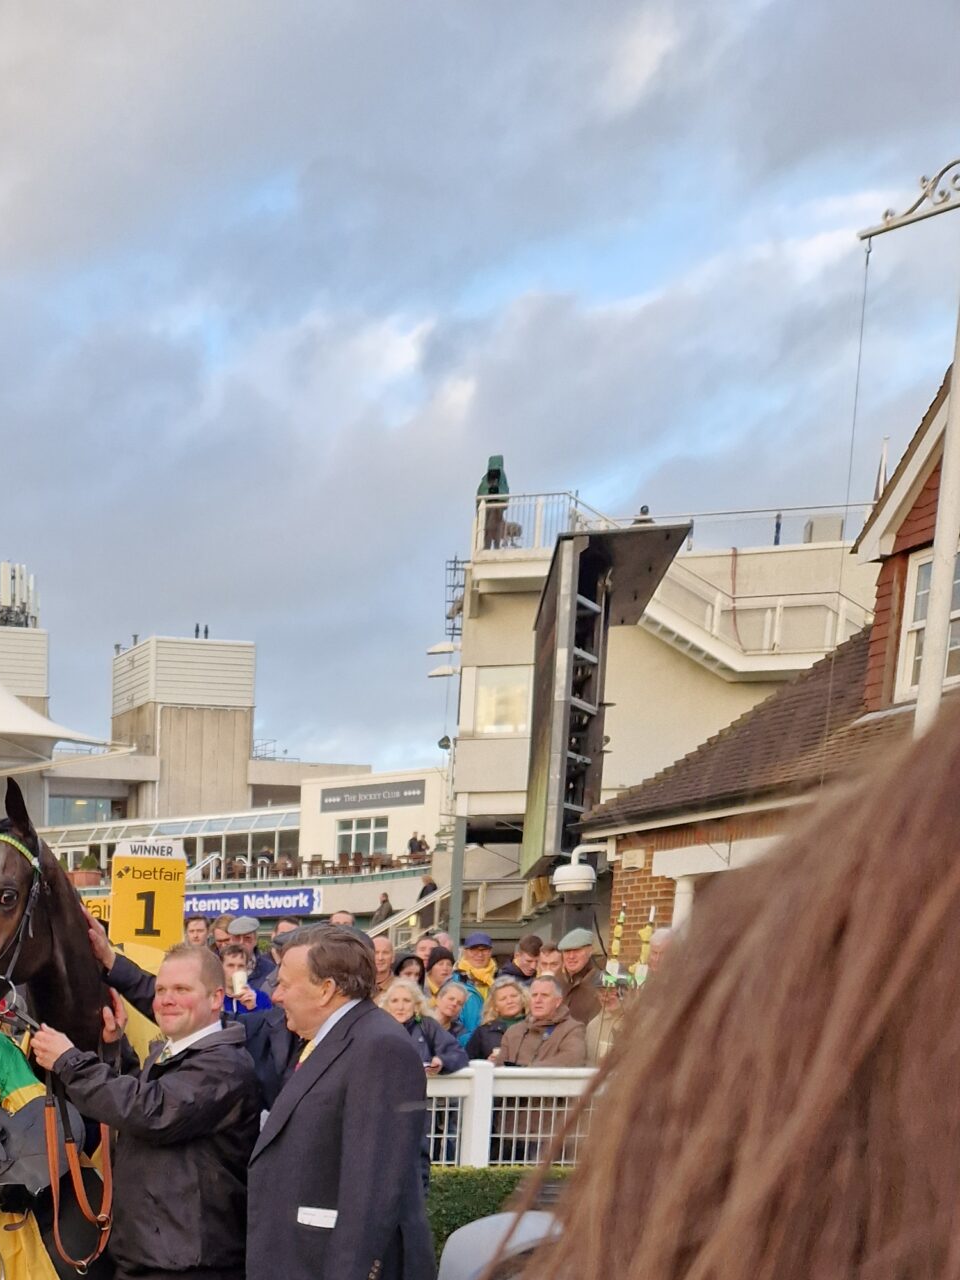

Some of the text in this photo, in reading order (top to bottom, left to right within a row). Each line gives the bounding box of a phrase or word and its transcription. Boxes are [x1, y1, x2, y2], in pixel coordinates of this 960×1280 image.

[130, 845, 173, 857] WINNER
[132, 866, 184, 882] betfair
[184, 891, 309, 913] rtemps Network
[135, 891, 161, 937] 1
